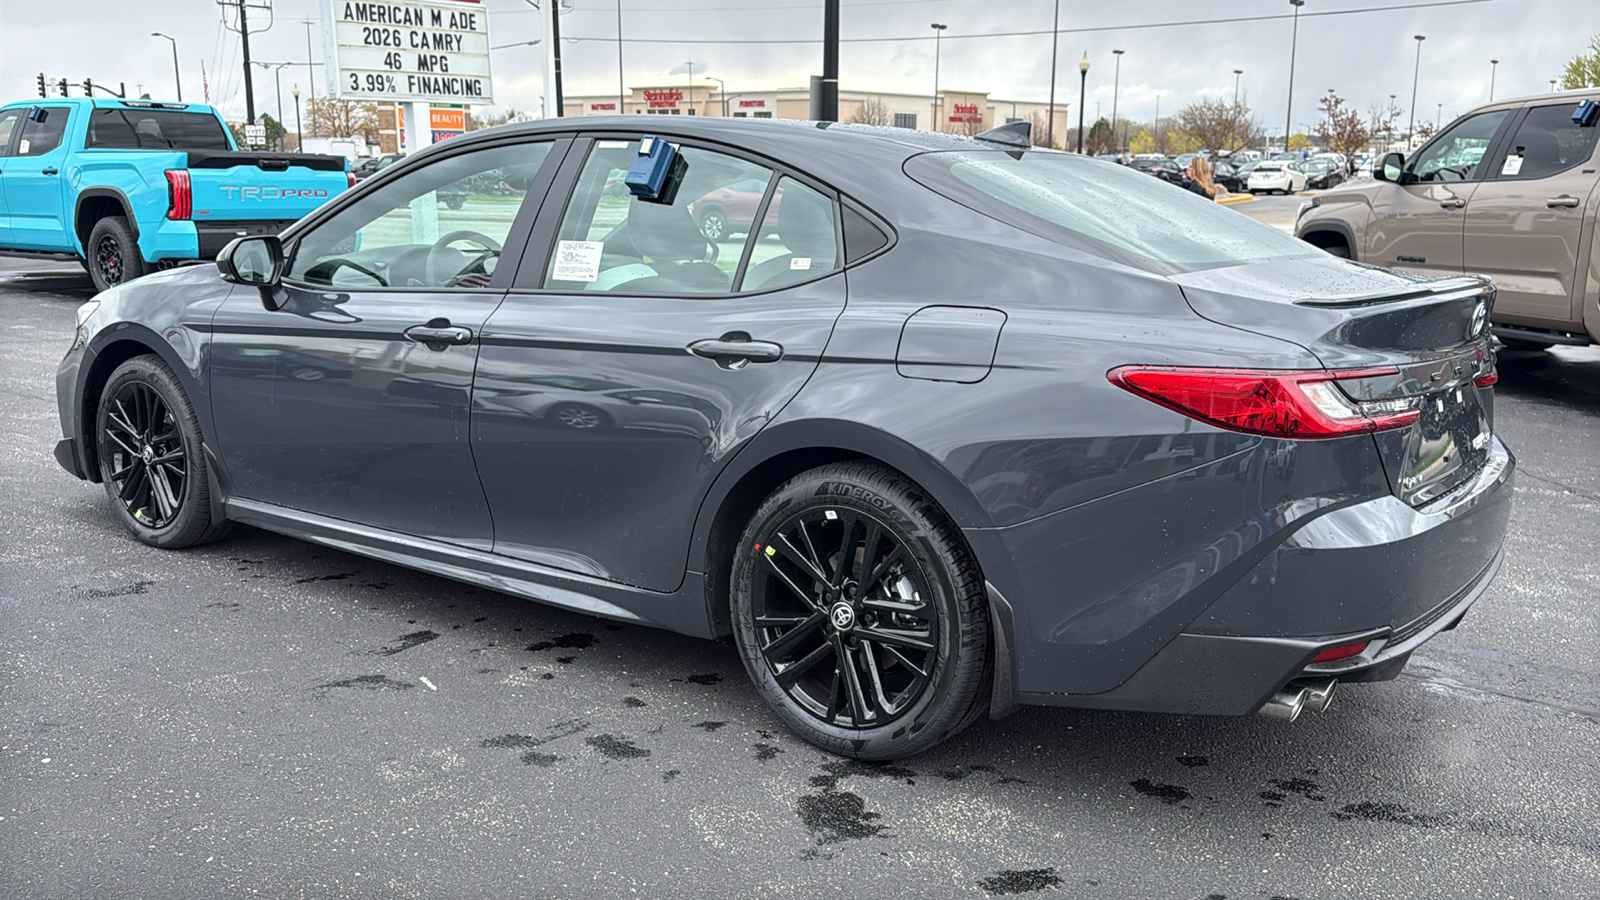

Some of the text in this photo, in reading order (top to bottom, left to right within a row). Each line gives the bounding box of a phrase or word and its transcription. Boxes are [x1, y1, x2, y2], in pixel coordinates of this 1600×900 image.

[344, 2, 423, 26] AMERICAN
[363, 27, 463, 52] 2026 CAMRY
[384, 52, 449, 73] 46 MPG
[350, 73, 482, 96] 3.99% FINANCING
[432, 114, 463, 124] BEAUTY
[219, 185, 328, 202] TRD PRO
[827, 482, 893, 510] KINERGY
